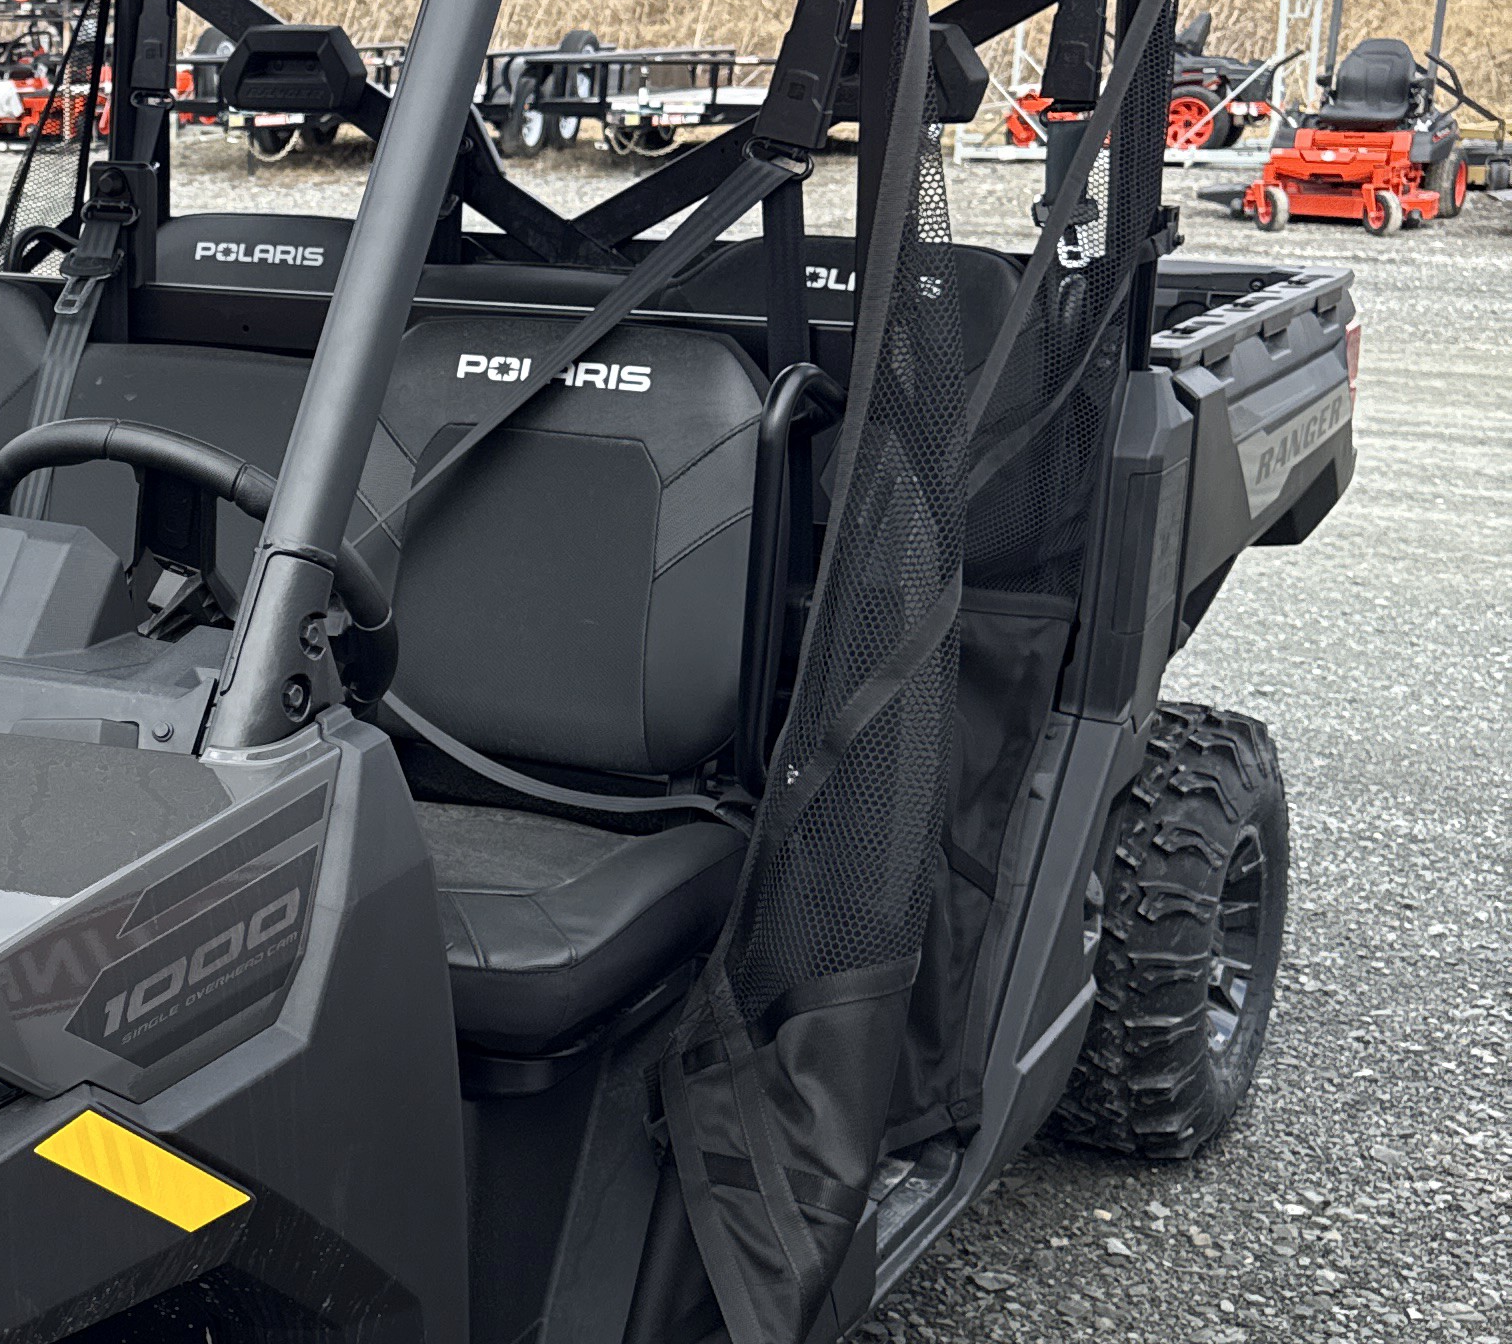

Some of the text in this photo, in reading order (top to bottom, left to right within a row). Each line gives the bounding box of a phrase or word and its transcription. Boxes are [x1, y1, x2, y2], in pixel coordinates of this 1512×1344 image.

[194, 241, 325, 267] POLARIS
[1255, 395, 1343, 487] RANGER
[103, 886, 301, 1038] 1000
[120, 1004, 180, 1046] SINGLE
[267, 931, 299, 956] CAM
